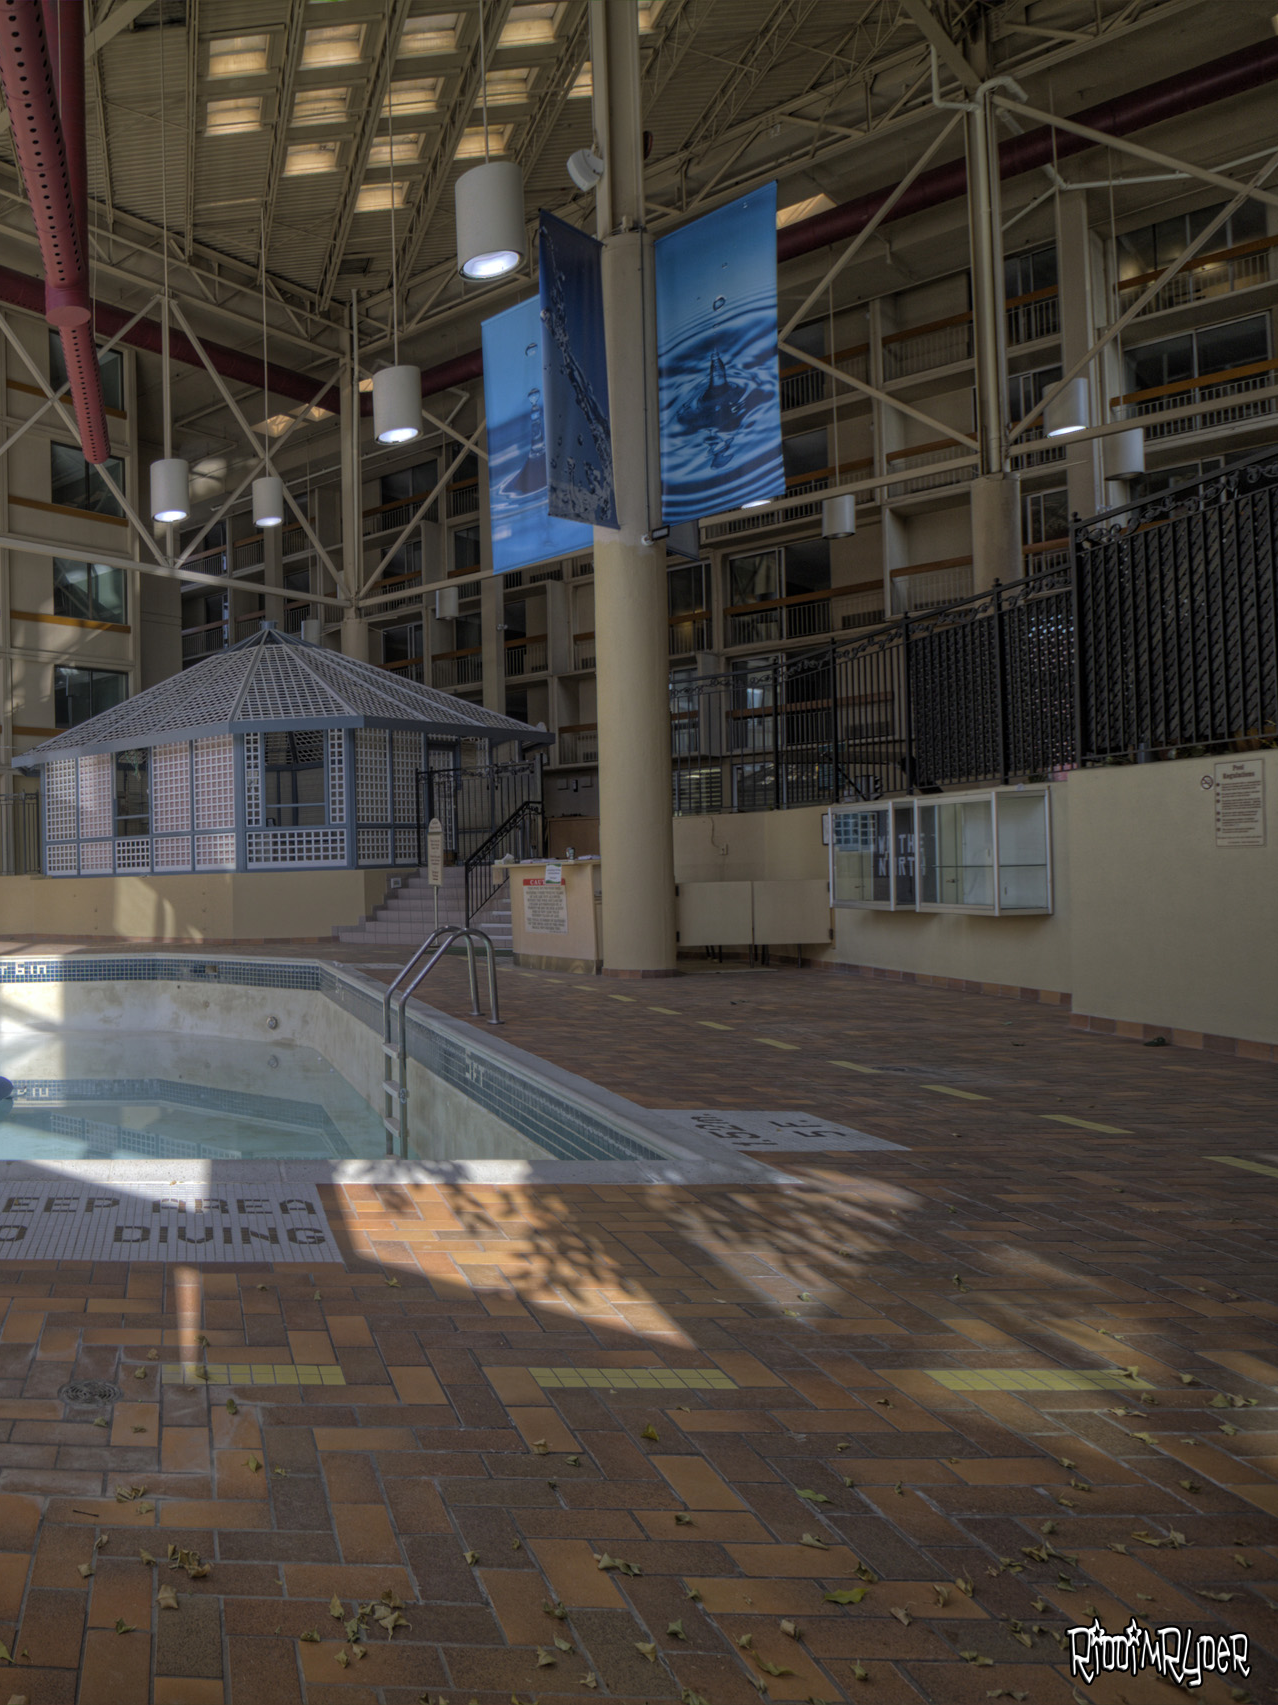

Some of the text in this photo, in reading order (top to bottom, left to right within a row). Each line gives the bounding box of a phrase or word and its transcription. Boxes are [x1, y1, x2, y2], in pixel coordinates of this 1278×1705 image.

[878, 856, 926, 876] NRTH
[152, 1197, 317, 1215] AREA
[112, 1225, 327, 1245] DIVING
